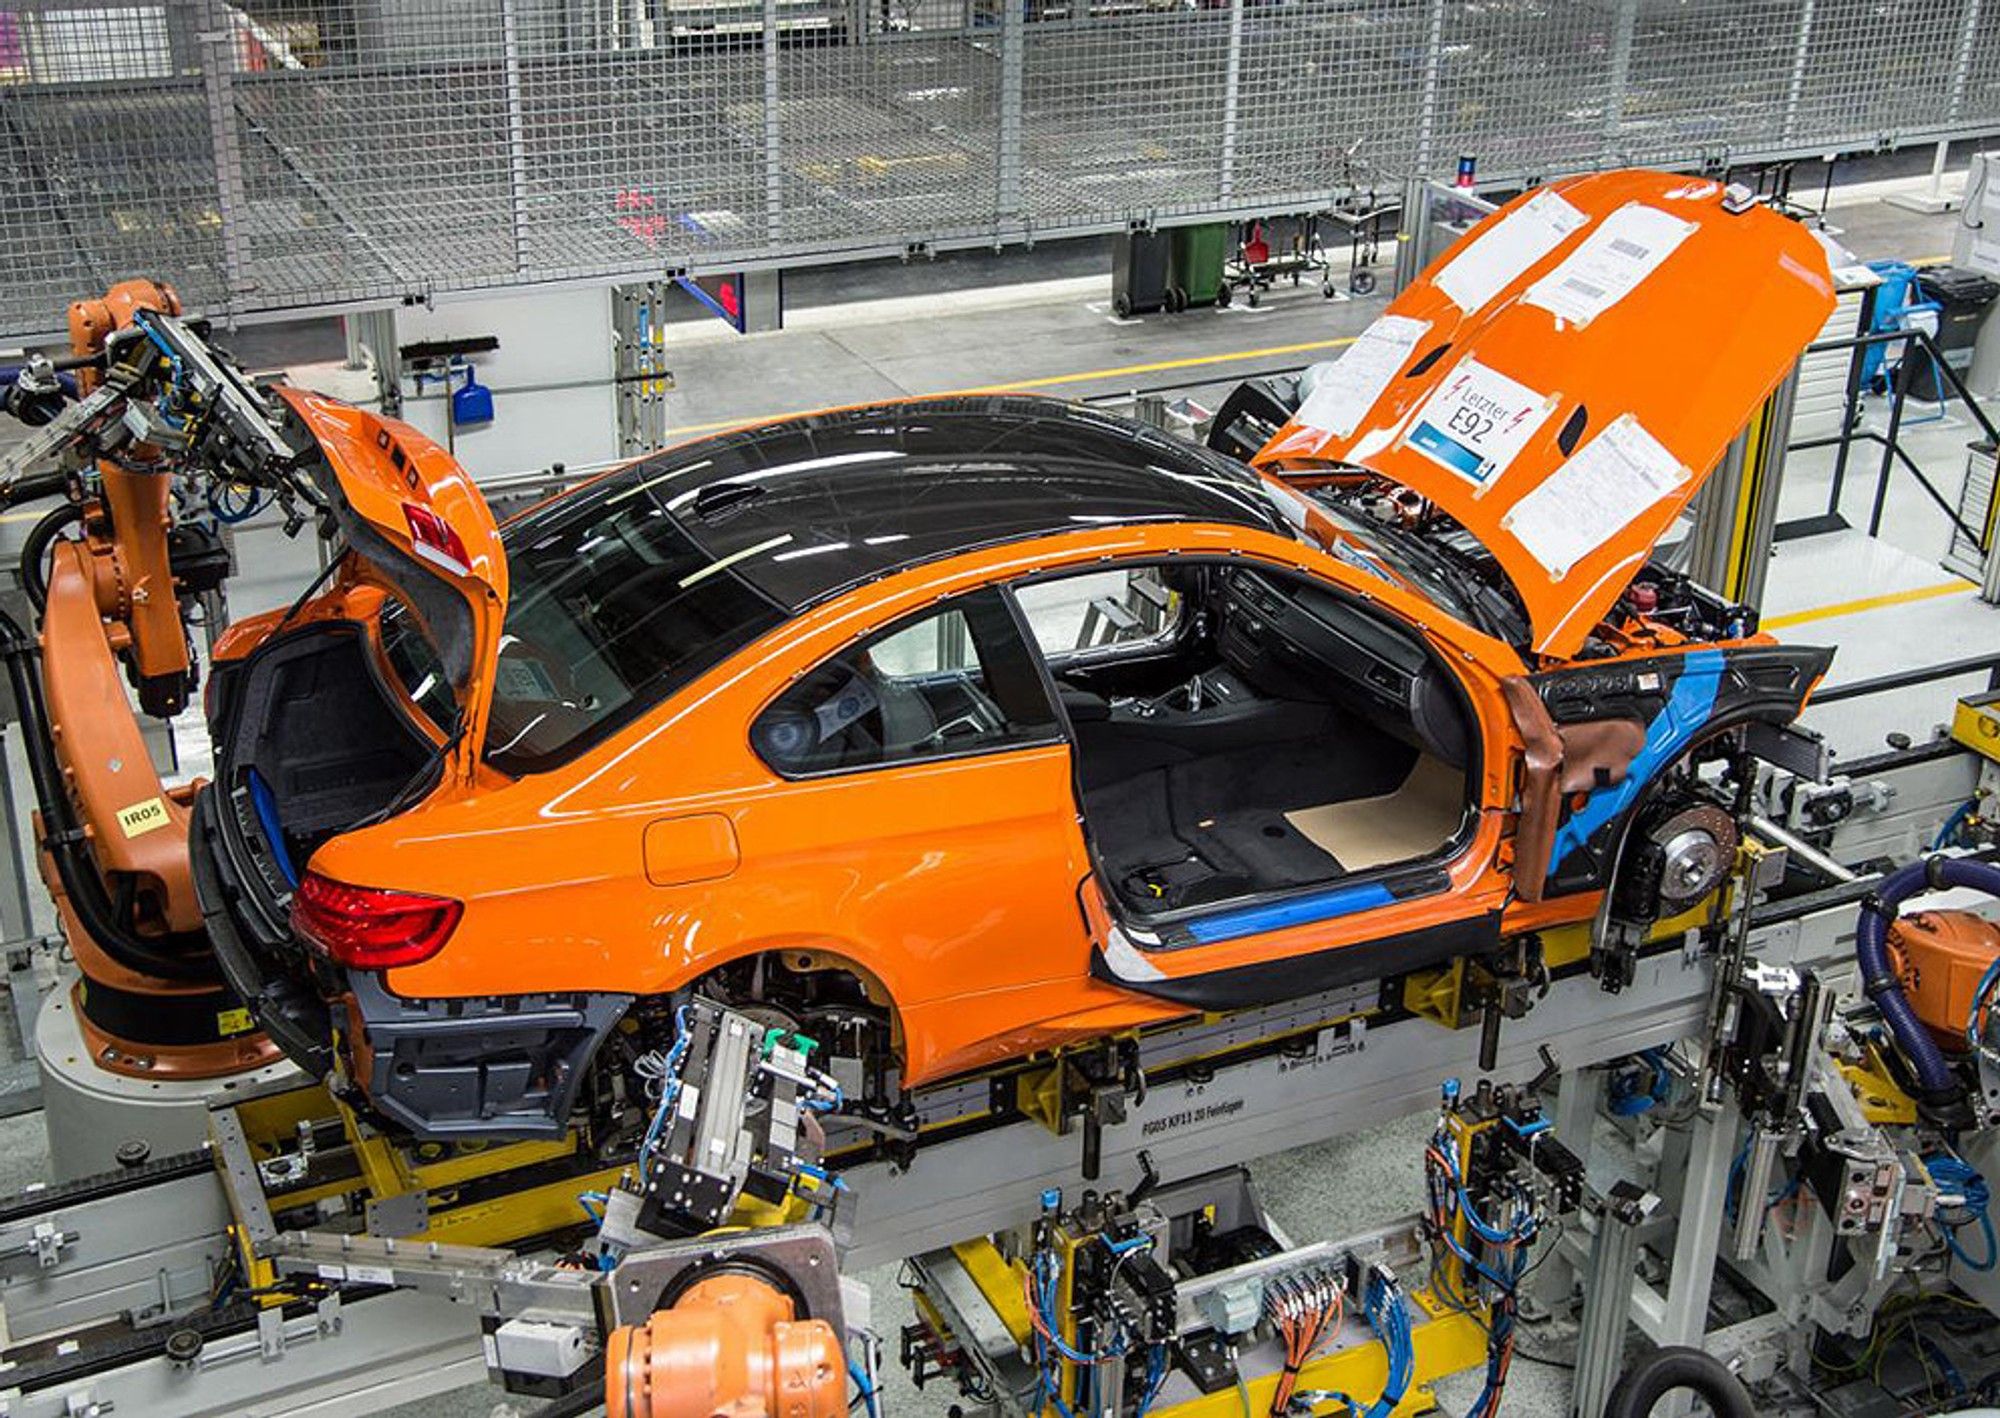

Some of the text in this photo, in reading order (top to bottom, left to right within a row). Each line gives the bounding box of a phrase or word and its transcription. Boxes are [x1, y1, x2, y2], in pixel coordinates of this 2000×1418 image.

[1461, 386, 1510, 421] Letzter
[1448, 406, 1494, 444] E92
[124, 804, 161, 826] IR05
